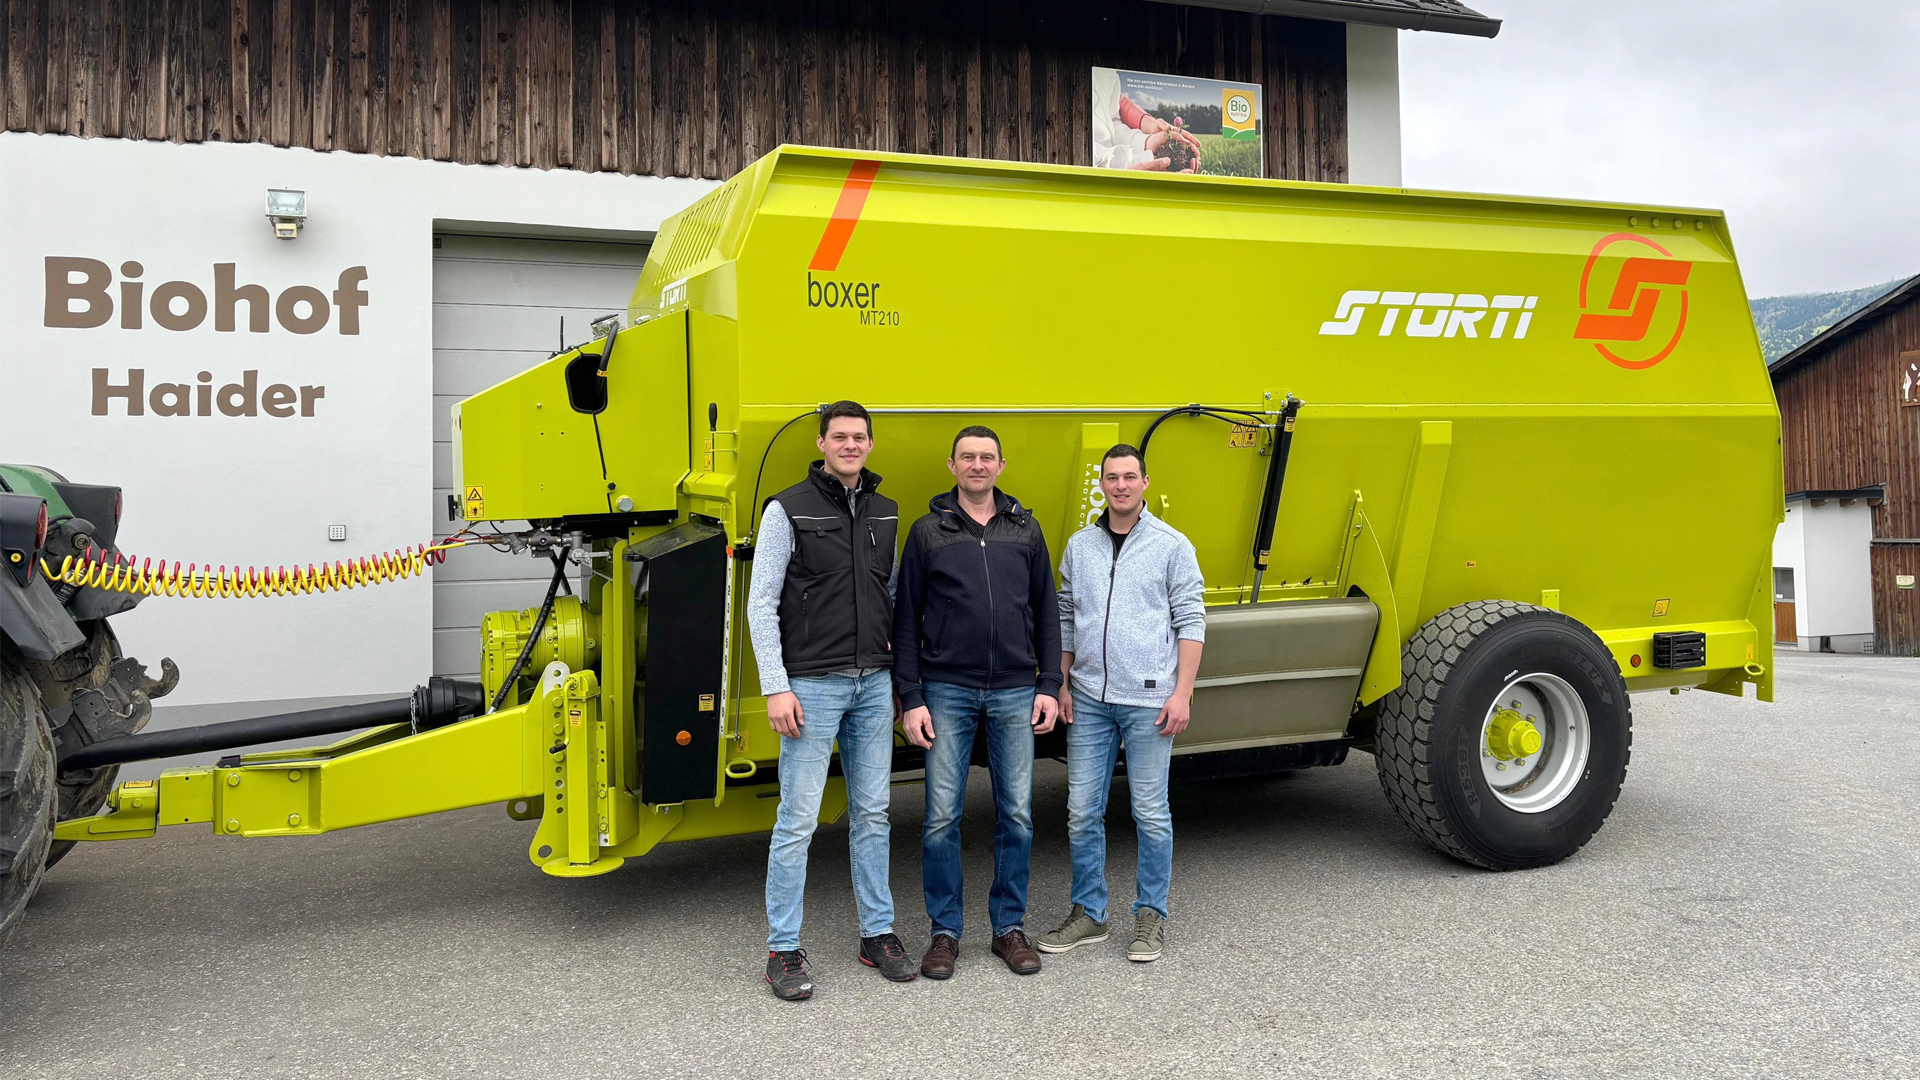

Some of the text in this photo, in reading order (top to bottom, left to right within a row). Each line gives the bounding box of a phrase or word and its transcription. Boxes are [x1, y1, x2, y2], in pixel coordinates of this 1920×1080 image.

[1230, 99, 1248, 113] Bio
[43, 256, 369, 335] Biohof
[807, 271, 881, 309] boxer
[859, 310, 900, 326] MT210
[1318, 289, 1539, 340] STORTI
[91, 367, 325, 418] Haider
